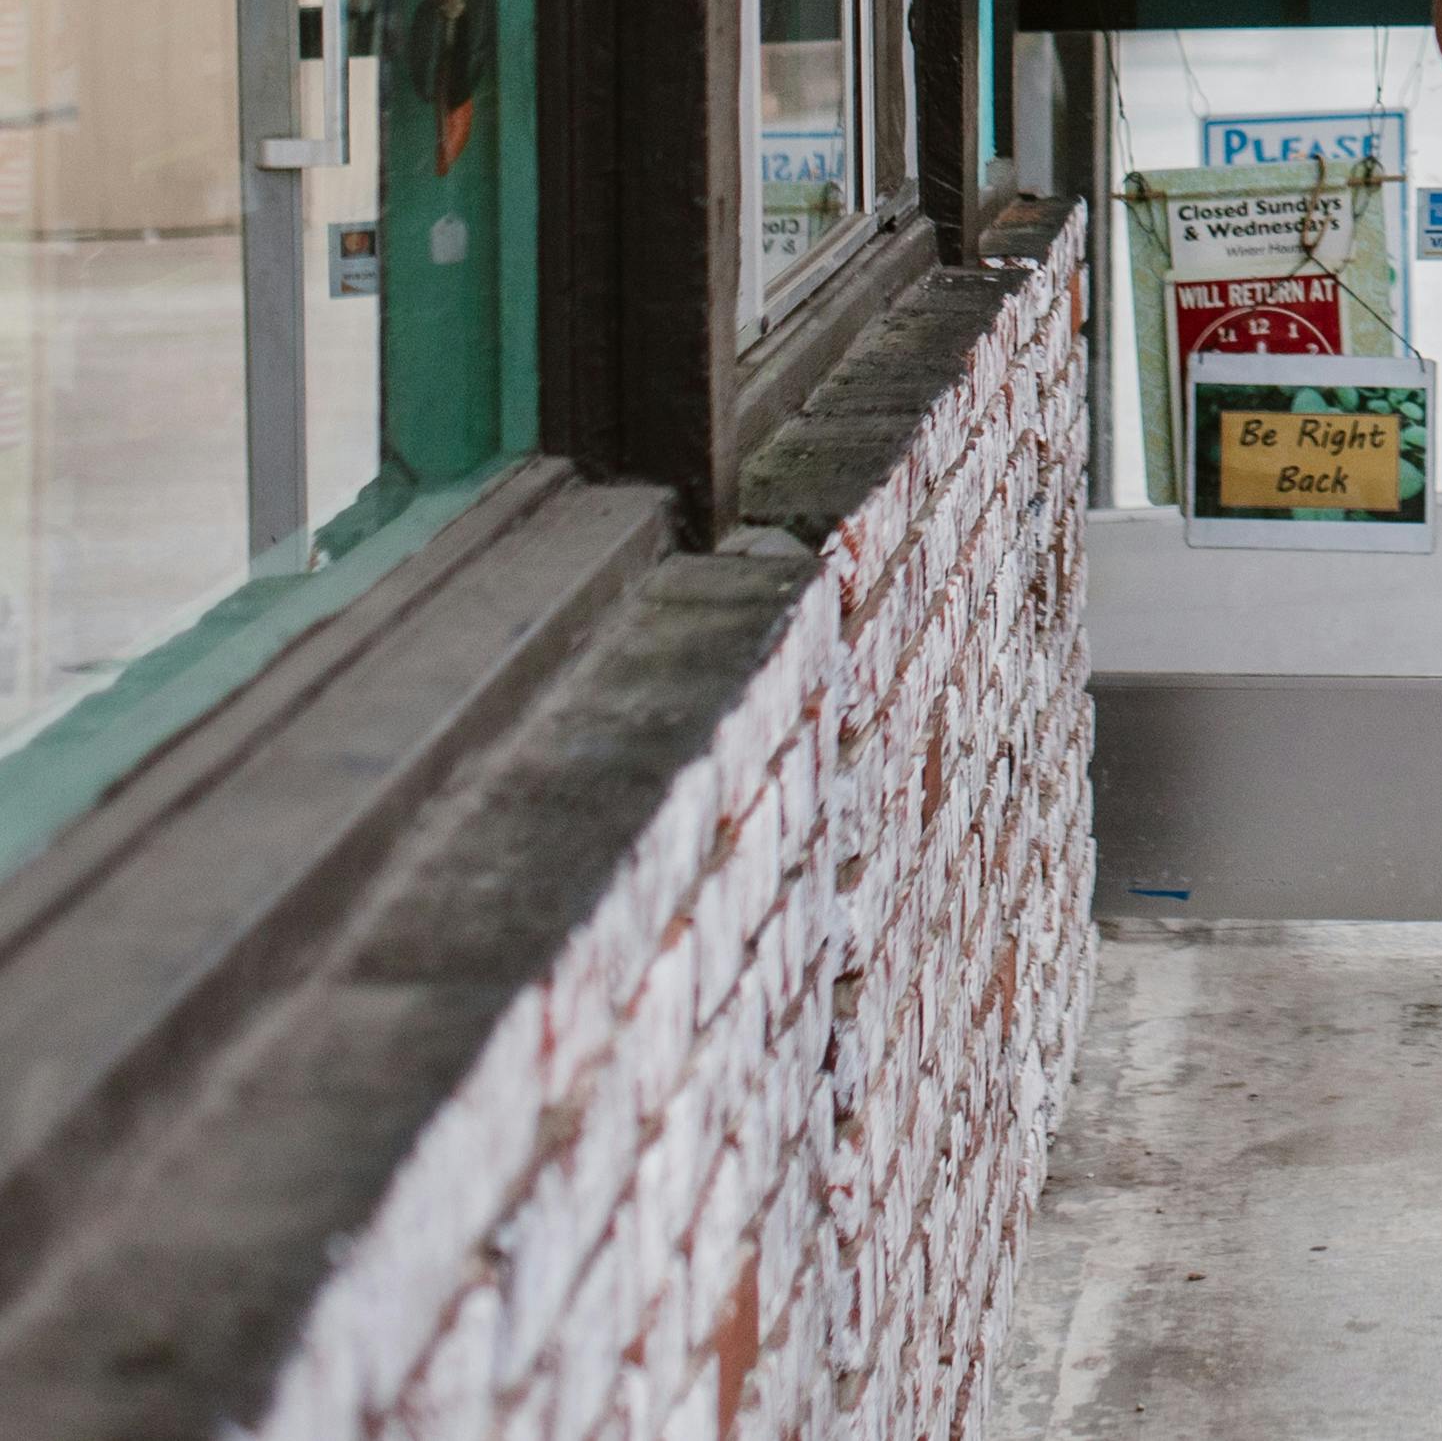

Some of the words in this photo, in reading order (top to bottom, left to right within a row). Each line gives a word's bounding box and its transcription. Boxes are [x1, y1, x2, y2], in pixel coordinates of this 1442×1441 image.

[1223, 127, 1382, 165] PLEASE
[1178, 201, 1249, 222] Closed
[1183, 225, 1199, 242] &
[1206, 218, 1341, 239] Wednesdays
[1268, 243, 1309, 257] Hour
[1177, 284, 1225, 310] WILL
[1228, 278, 1305, 307] RETURN
[1309, 279, 1337, 303] AT
[1249, 317, 1271, 335] 12
[1288, 323, 1300, 339] 1
[1239, 419, 1278, 448] Be
[1297, 419, 1387, 456] Right
[1277, 465, 1349, 494] Back
